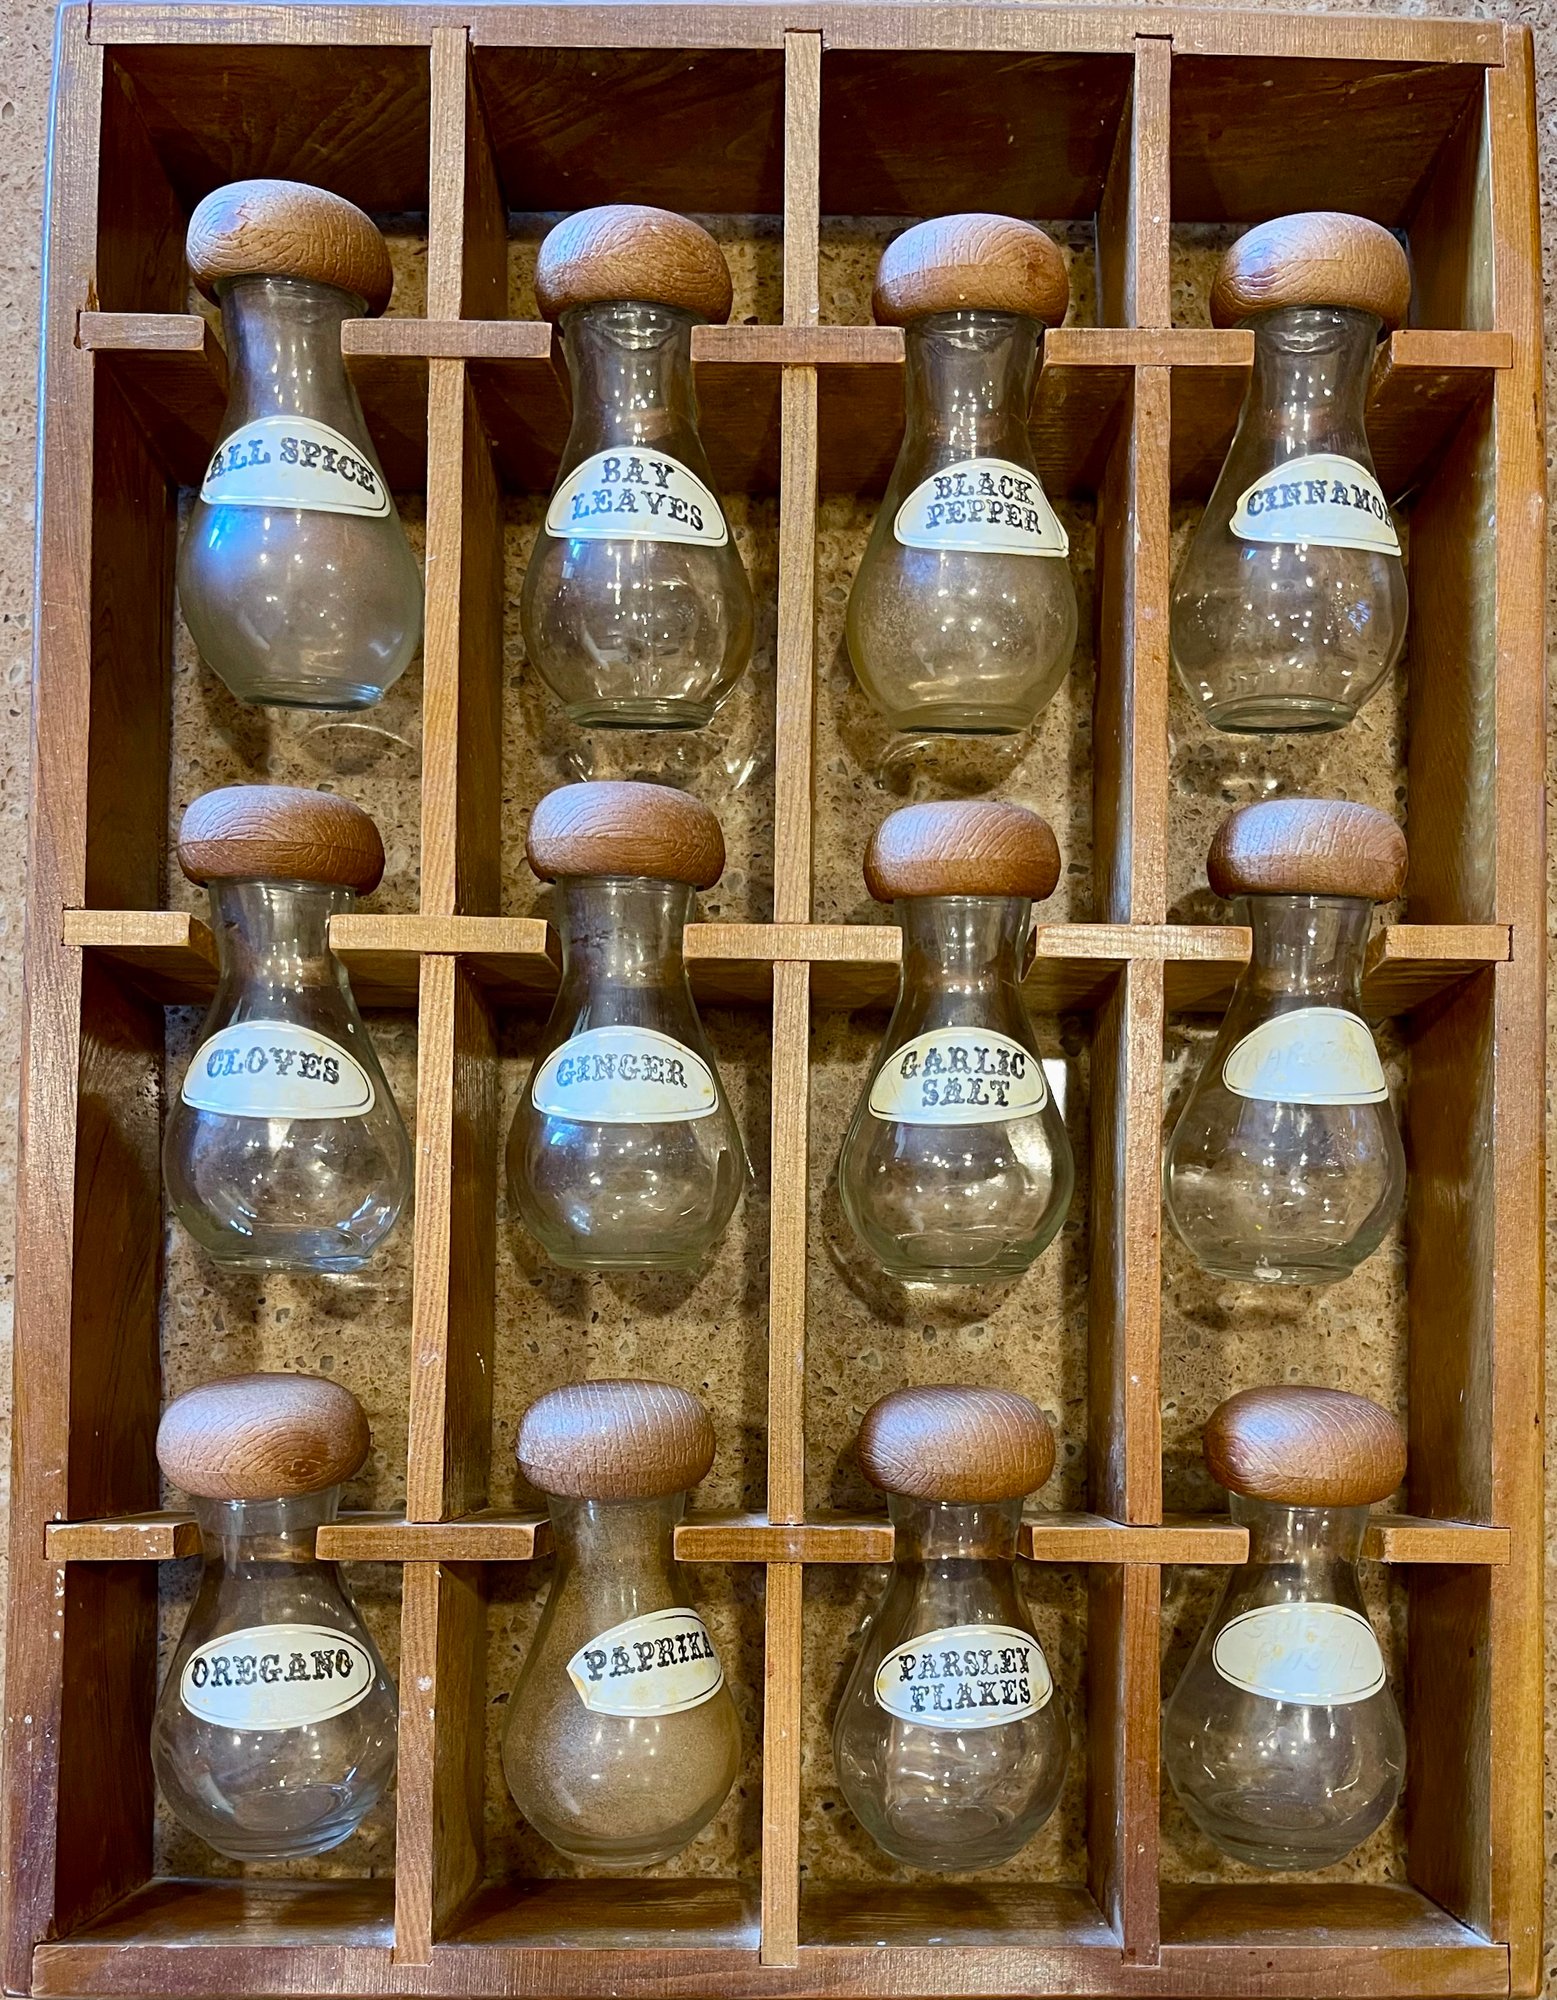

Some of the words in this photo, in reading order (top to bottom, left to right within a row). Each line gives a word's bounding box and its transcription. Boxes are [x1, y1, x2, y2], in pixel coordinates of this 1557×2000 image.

[205, 439, 272, 483] ALL
[279, 438, 376, 495] SPICE
[600, 457, 675, 489] BAY
[933, 473, 1034, 506] BLACK
[571, 489, 703, 532] LEAVES
[925, 500, 1043, 535] PEPPER
[206, 1047, 340, 1085] CLOVES
[555, 1054, 688, 1088] GINGER
[900, 1046, 1026, 1081] GARLIC
[921, 1078, 1010, 1107] SALT
[190, 1649, 354, 1688] OREGANO
[583, 1631, 715, 1681] PAPRIKA
[898, 1648, 1030, 1682] PARSLEY
[909, 1679, 1031, 1713] FLAKES
